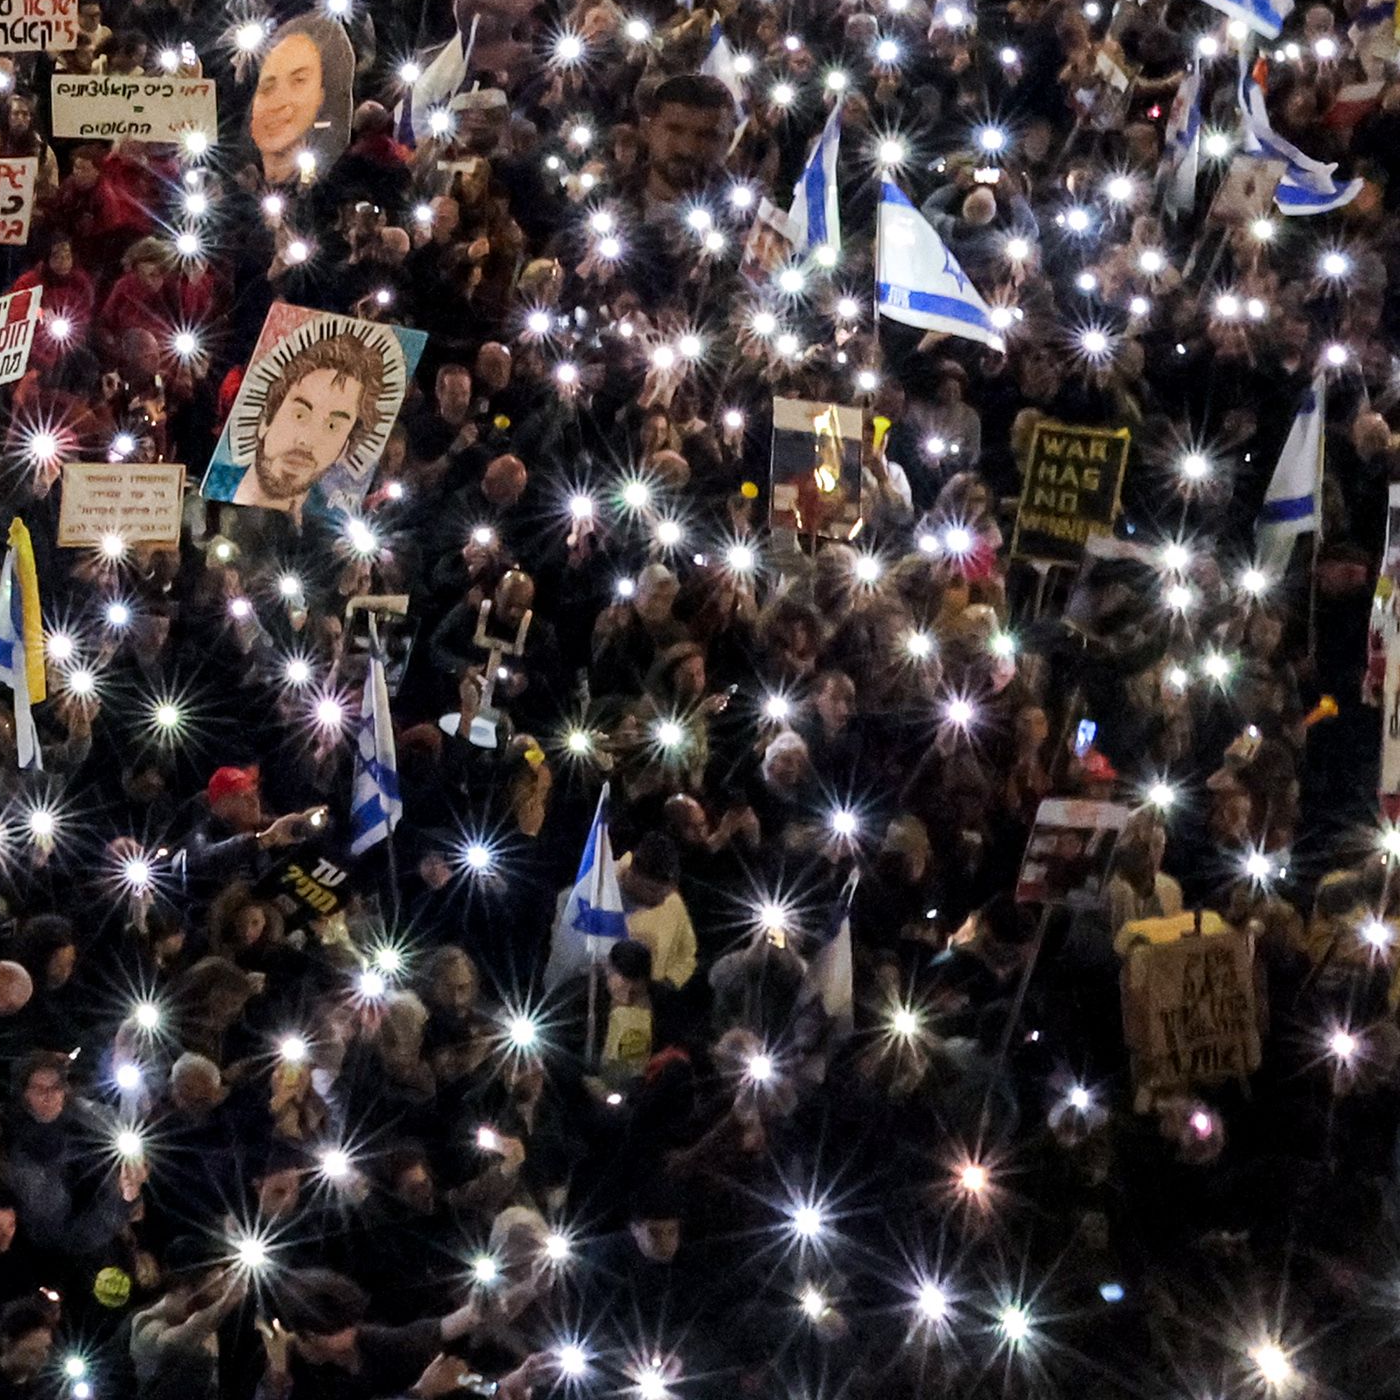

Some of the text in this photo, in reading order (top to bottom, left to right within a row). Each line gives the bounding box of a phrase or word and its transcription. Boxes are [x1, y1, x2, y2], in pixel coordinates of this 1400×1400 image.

[144, 84, 174, 98] כיס
[179, 84, 209, 98] דמי
[1043, 434, 1108, 462] WAR
[1038, 461, 1100, 491] HAS
[1034, 487, 1079, 512] NO
[311, 857, 347, 888] עד
[282, 865, 338, 914] מתי?
